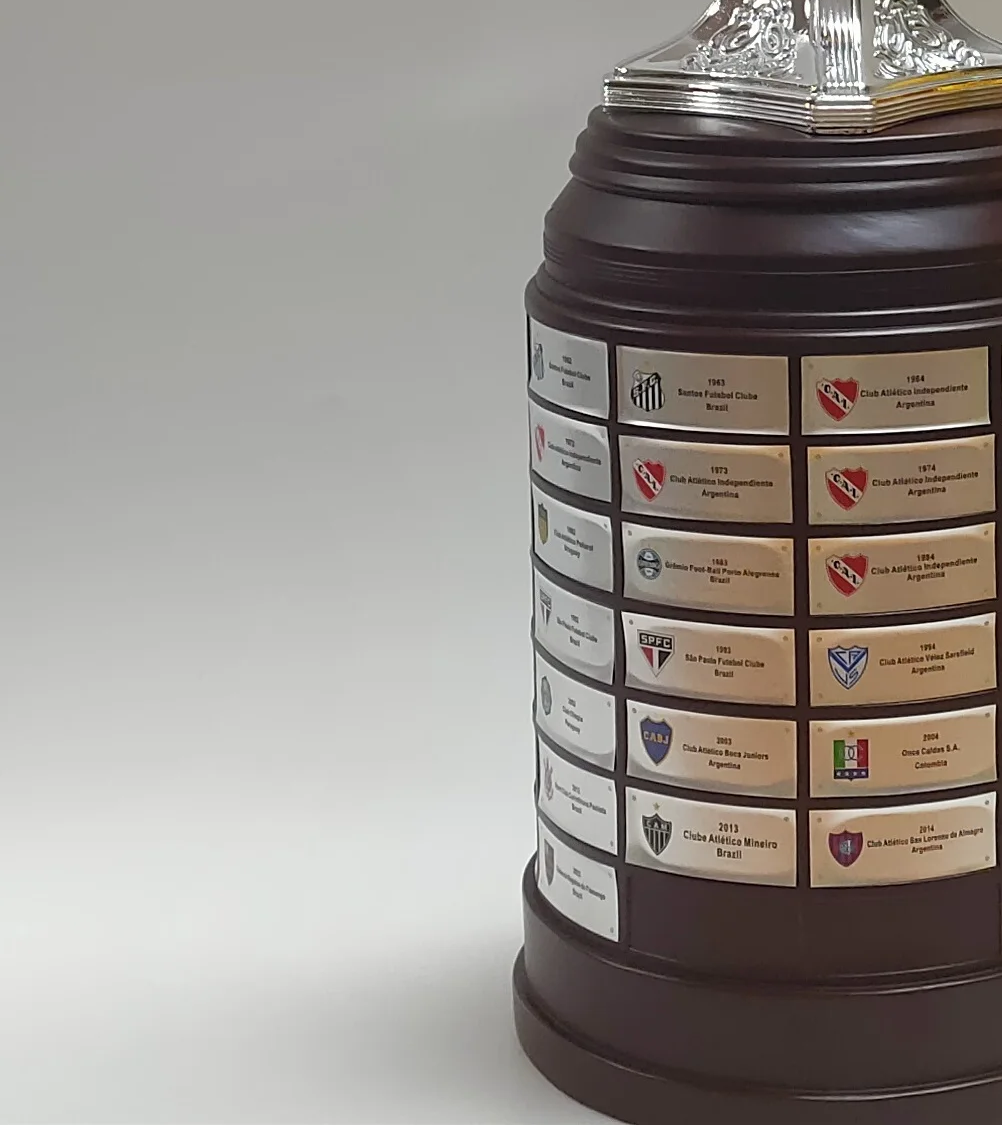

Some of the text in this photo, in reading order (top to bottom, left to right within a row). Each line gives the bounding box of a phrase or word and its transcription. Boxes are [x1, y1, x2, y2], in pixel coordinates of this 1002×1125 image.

[670, 475, 686, 484] Club
[872, 478, 891, 487] Club
[908, 487, 946, 497] Argentina
[871, 567, 890, 575] Club
[641, 634, 672, 648] SPFC
[879, 658, 896, 666] Club
[911, 664, 945, 675] Argentina
[682, 744, 697, 752] Club
[718, 822, 739, 833] 2013
[919, 825, 934, 833] 2014
[683, 830, 777, 849] Clube Atlético Mineiro
[867, 839, 882, 848] Club
[959, 826, 983, 837] Almagro
[717, 848, 742, 859] Brazil
[911, 844, 943, 854] Argentina
